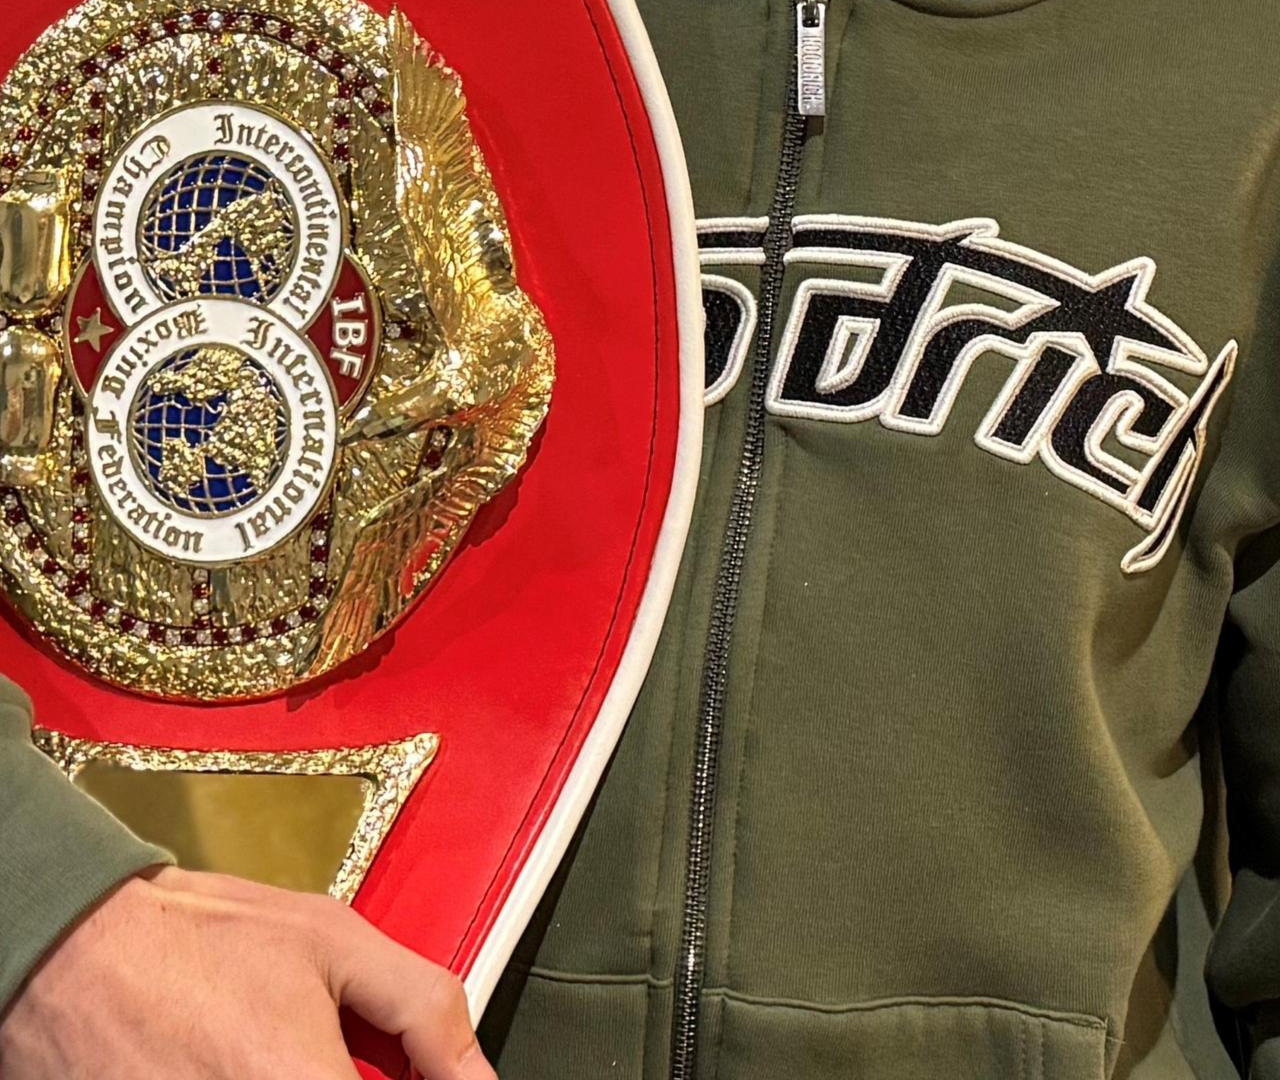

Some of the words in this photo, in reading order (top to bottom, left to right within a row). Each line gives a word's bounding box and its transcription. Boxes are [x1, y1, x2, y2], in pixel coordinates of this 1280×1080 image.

[99, 134, 171, 314] Champion
[213, 112, 339, 319] Intercontinental
[100, 304, 208, 402] Boxing
[329, 292, 367, 381] IBF
[92, 405, 204, 554] Federation
[233, 316, 327, 553] International
